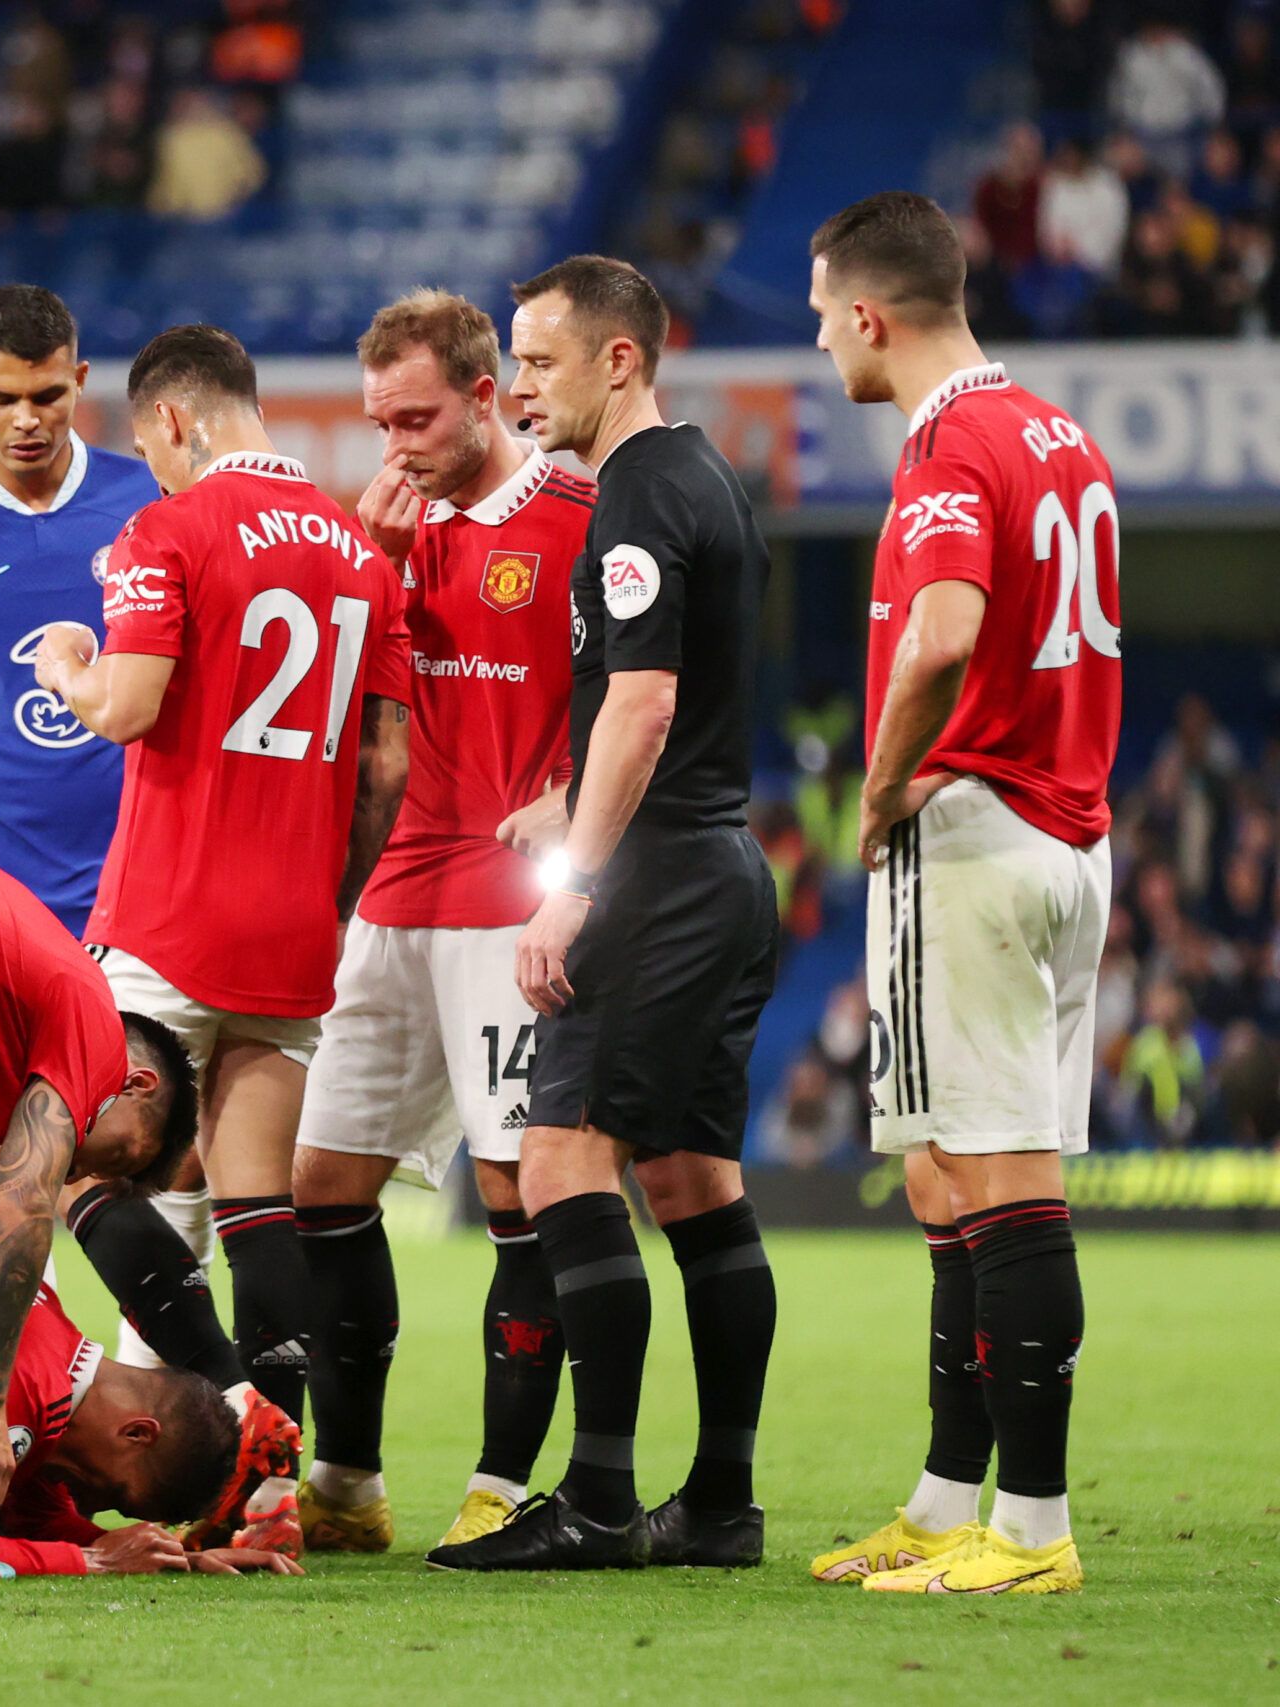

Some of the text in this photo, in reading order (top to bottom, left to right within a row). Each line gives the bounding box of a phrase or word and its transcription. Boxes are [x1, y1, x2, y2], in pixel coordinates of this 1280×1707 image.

[898, 491, 980, 544] DXC
[906, 523, 980, 555] TECHNOLOGY
[237, 508, 375, 571] ANTONY
[609, 561, 645, 587] EA
[609, 585, 648, 600] SORTS
[1031, 480, 1122, 670] 20
[221, 587, 370, 763] 21
[412, 650, 529, 683] TeamViewer
[481, 1025, 536, 1095] 14
[500, 1118, 527, 1130] adid
